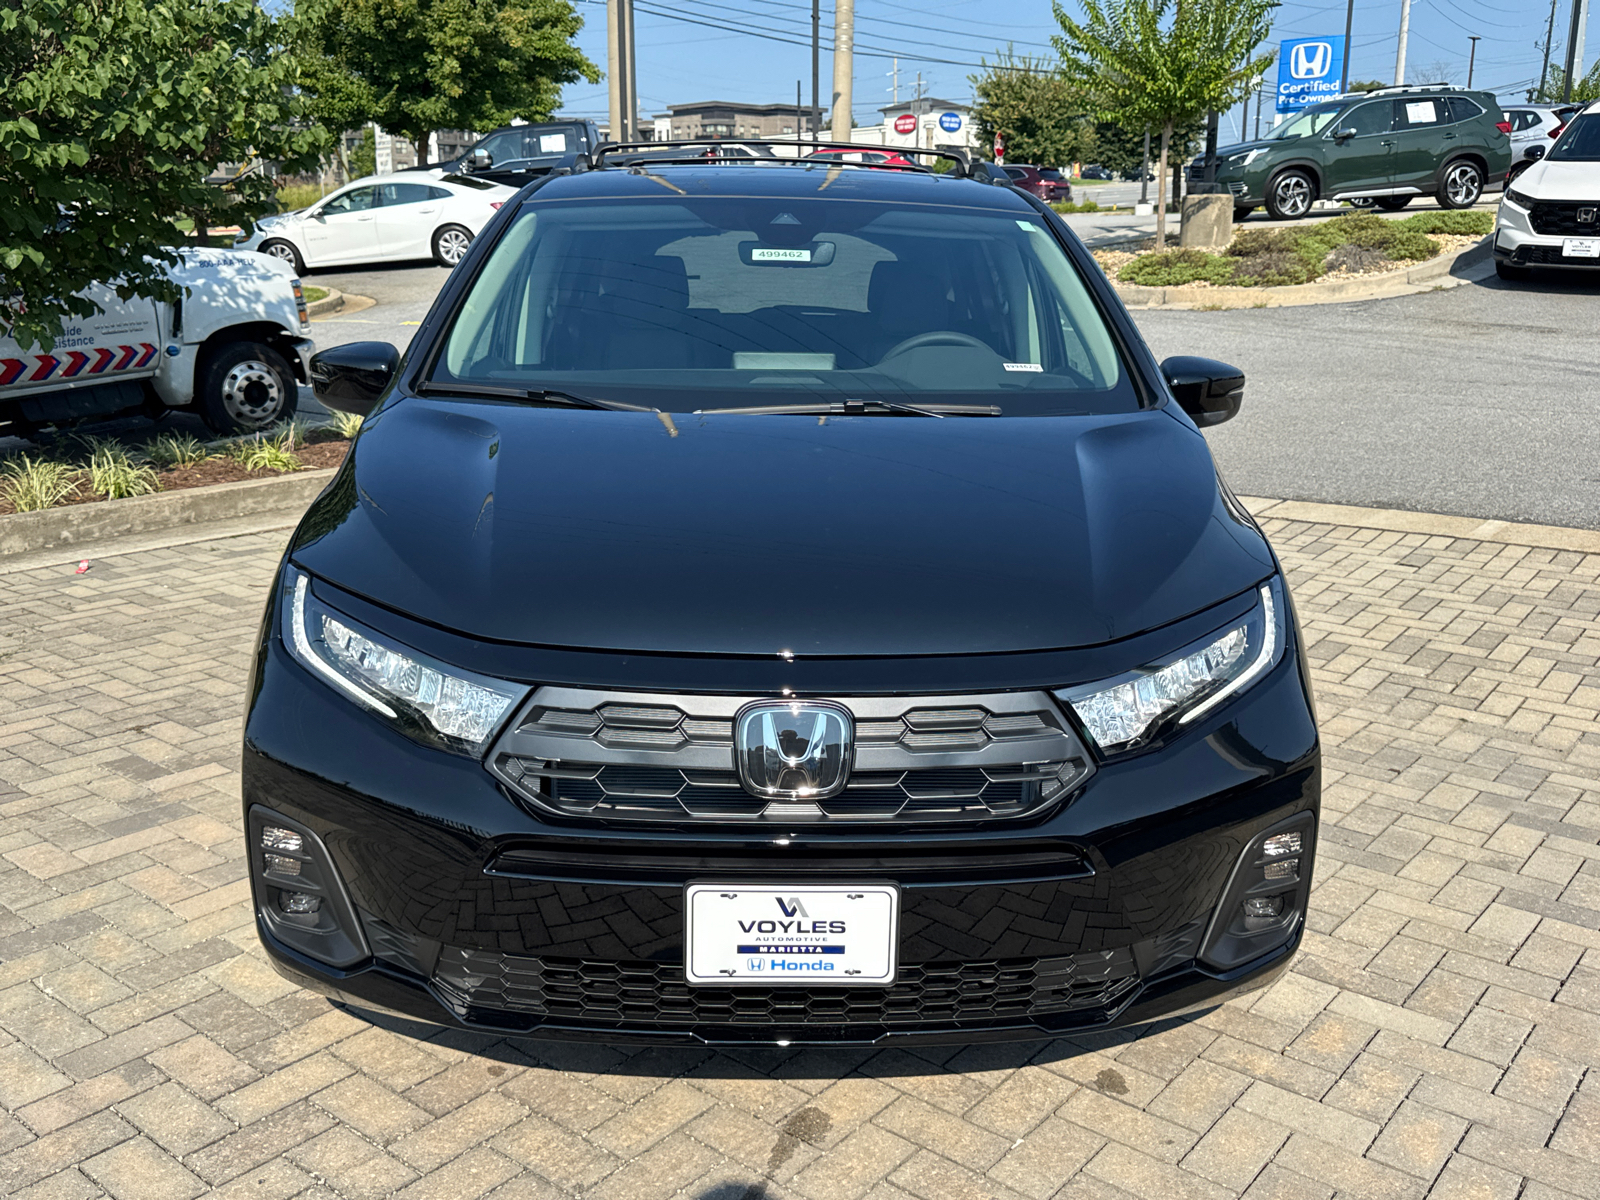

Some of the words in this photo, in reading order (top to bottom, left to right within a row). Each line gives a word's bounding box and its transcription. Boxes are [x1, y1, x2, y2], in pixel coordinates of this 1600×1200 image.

[1280, 80, 1339, 94] Certified
[758, 250, 803, 259] 499462
[737, 919, 847, 934] VOYLES
[770, 959, 835, 971] Honda
